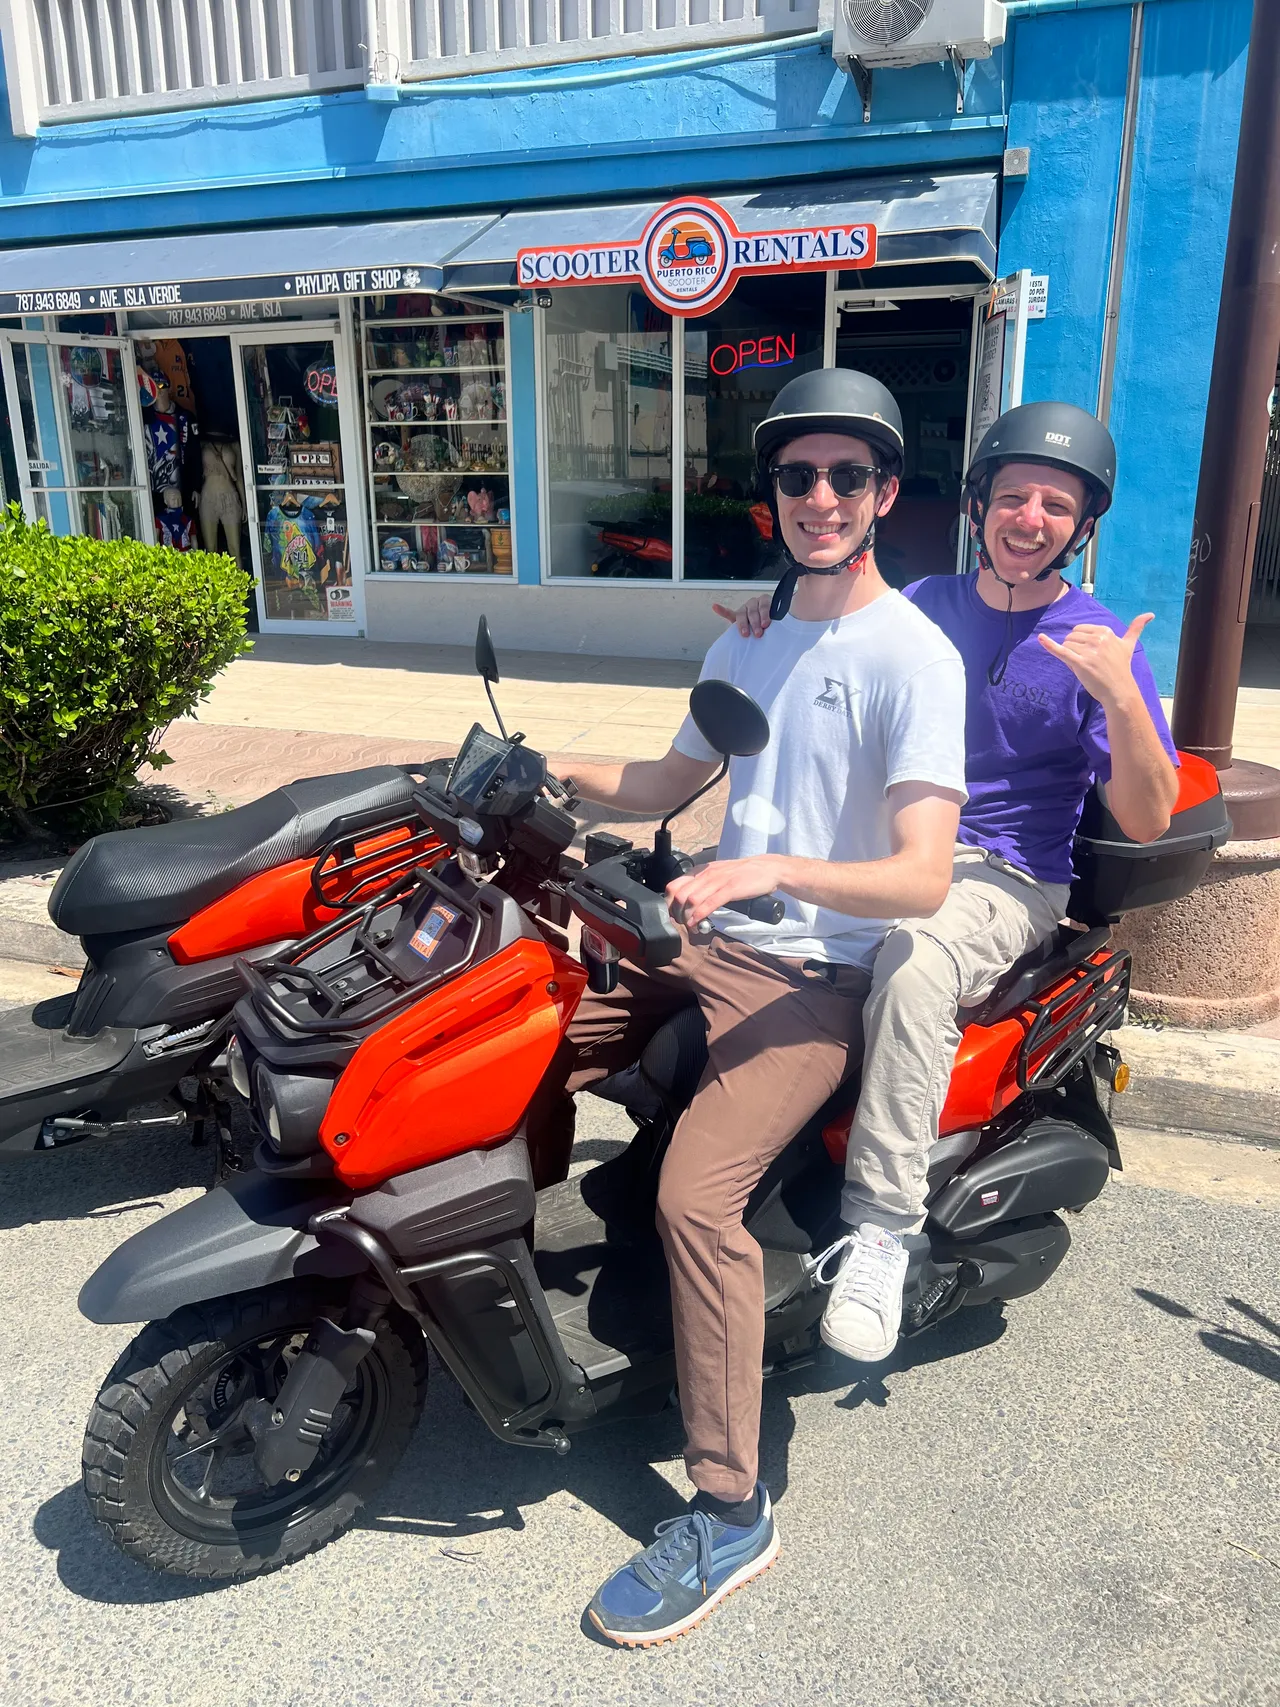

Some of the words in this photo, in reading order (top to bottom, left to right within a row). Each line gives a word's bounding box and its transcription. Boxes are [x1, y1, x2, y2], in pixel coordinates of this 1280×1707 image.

[521, 249, 641, 281] SCOOTER
[734, 229, 866, 265] RENTALS
[657, 268, 693, 278] PUERTO
[695, 266, 717, 276] RICO
[100, 289, 121, 308] AVE.
[124, 287, 146, 306] ISLA
[148, 284, 182, 304] VERDE
[295, 273, 340, 295] PHYLIPA
[343, 271, 367, 291] GIFT
[371, 269, 401, 290] SHOP
[668, 277, 706, 287] SCOOTER
[262, 301, 283, 318] ISLA
[710, 332, 796, 375] OPEN
[307, 370, 338, 397] OPE
[1045, 431, 1072, 446] DOT
[29, 462, 50, 470] SALIDA
[813, 700, 837, 712] DERBY
